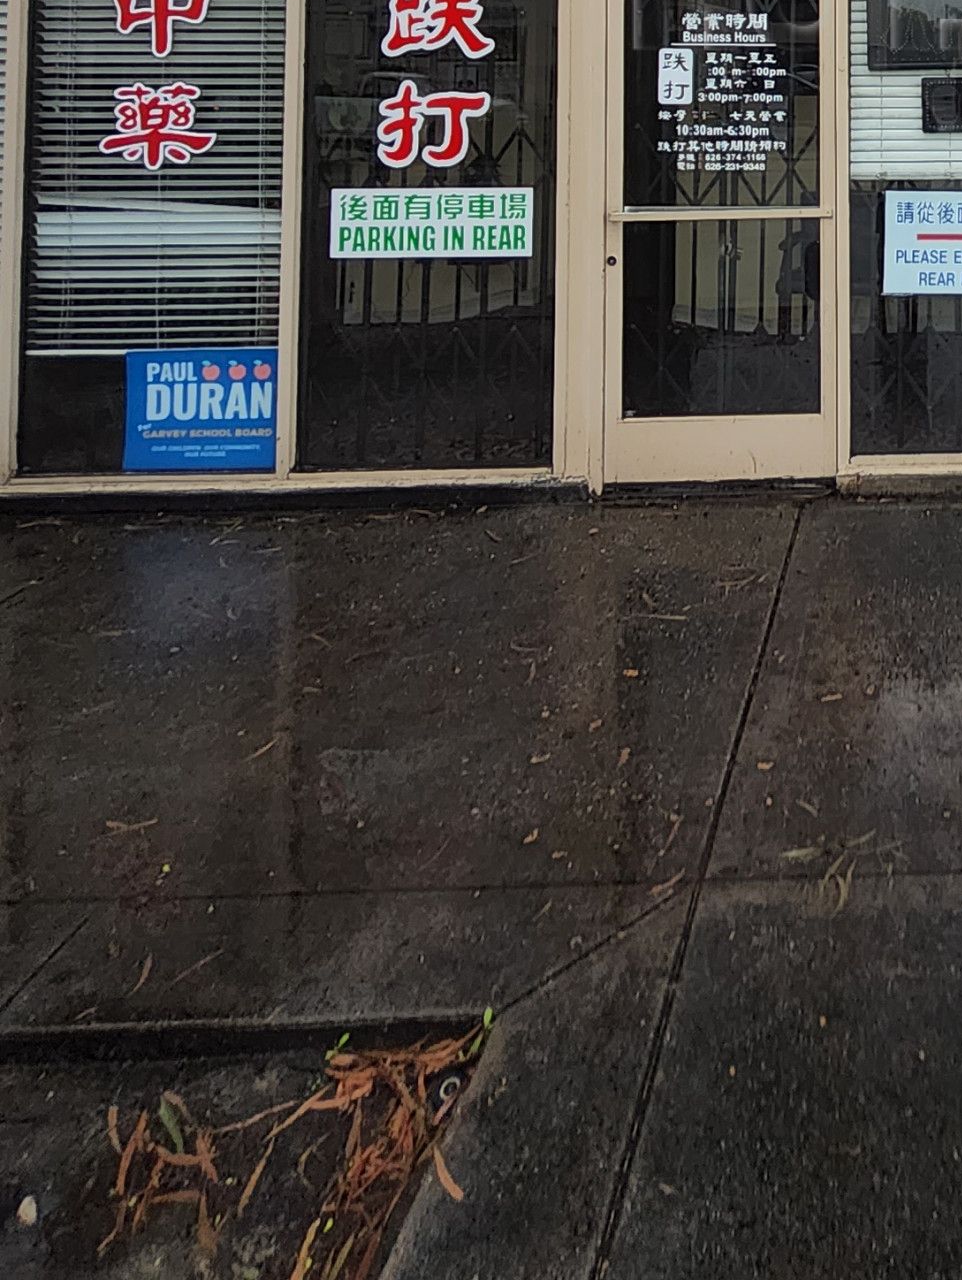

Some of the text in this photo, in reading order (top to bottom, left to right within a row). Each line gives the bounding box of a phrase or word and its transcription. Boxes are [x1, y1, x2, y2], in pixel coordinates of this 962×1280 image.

[681, 12, 768, 31] 營業時間
[682, 31, 766, 43] Business Hours
[661, 52, 690, 101] 跌打
[676, 124, 770, 138] 10:30am-6:30pm
[339, 193, 528, 222] 後面有停車場
[338, 224, 526, 252] PARKING IN REAR
[896, 250, 948, 264] PLEASE
[918, 272, 955, 287] REAR
[146, 362, 198, 383] PAUL
[146, 381, 273, 421] DURAN
[142, 427, 273, 439] GARVEY SCHOOL BOARD
